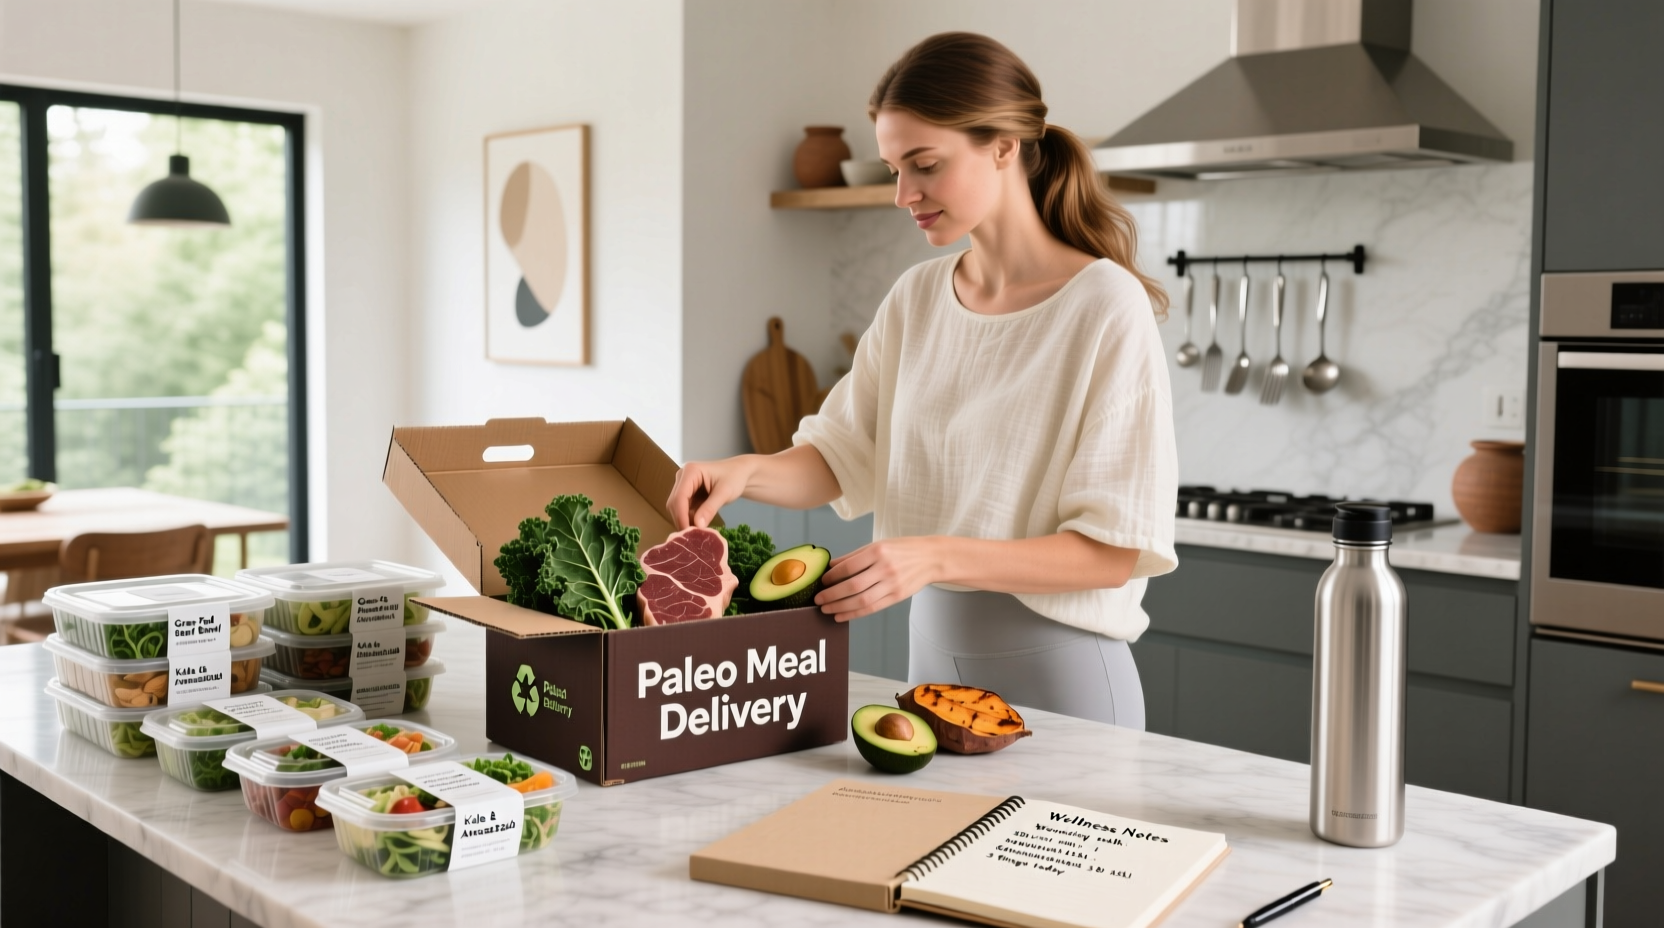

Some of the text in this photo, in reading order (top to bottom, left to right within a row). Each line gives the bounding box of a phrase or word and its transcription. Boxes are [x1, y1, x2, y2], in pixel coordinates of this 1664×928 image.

[638, 638, 827, 699] Paleo Meal
[660, 692, 808, 741] Delivery
[464, 813, 487, 826] Kale
[1050, 811, 1118, 834] Wellness
[1121, 827, 1170, 844] Notes
